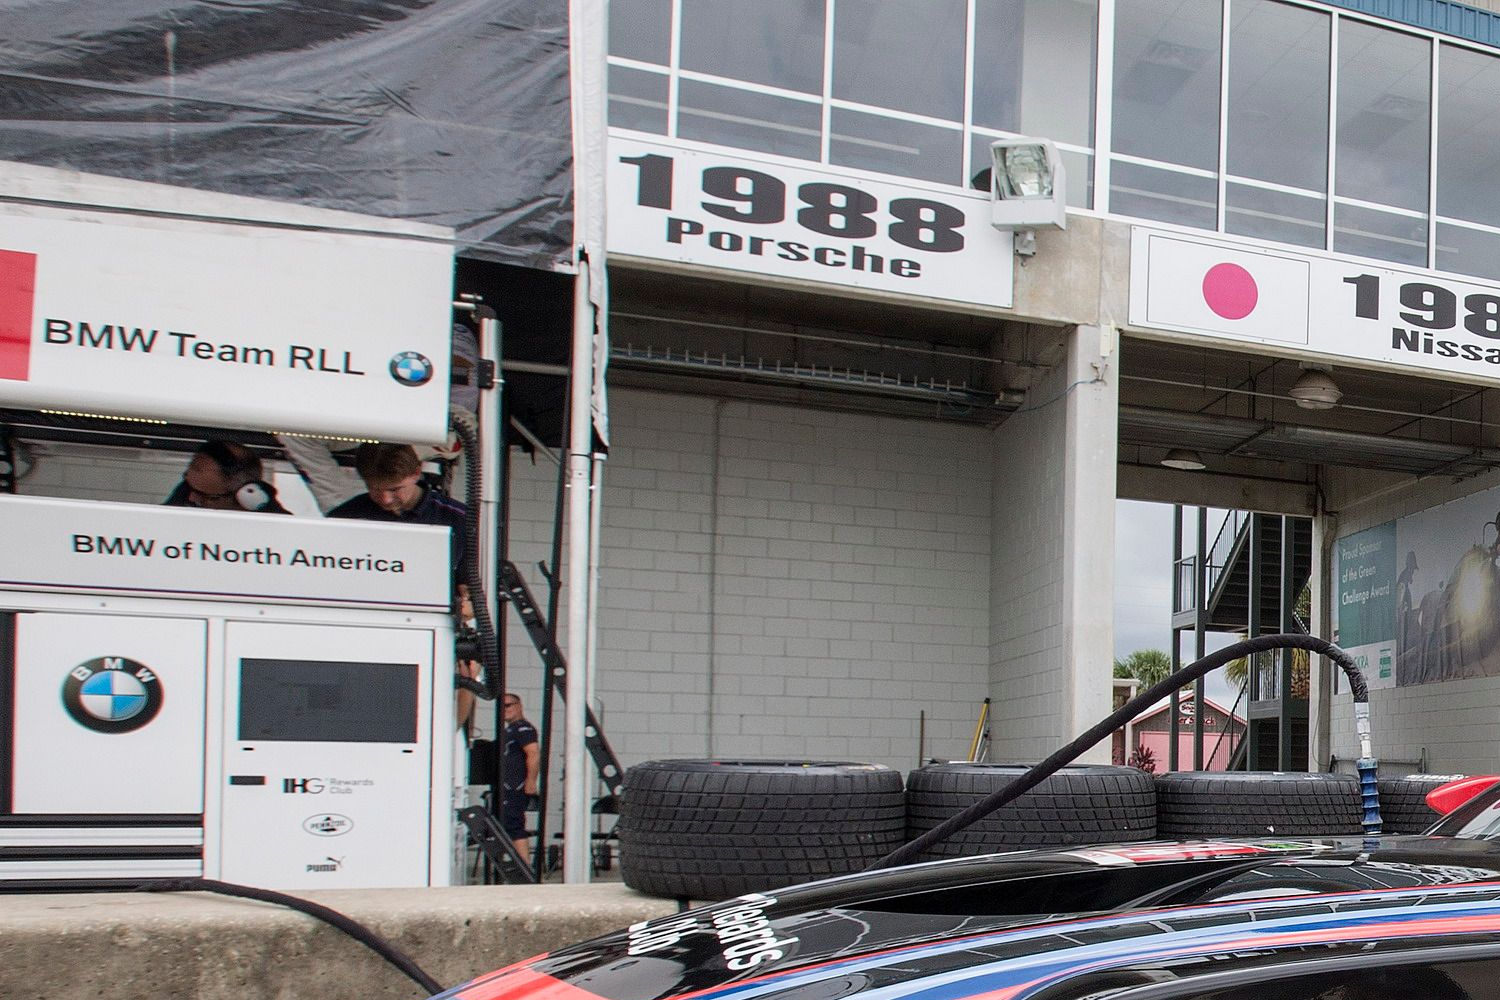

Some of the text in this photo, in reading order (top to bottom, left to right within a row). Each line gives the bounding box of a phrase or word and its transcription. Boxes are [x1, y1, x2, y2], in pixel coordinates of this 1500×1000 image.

[619, 153, 966, 253] 1988
[666, 217, 921, 279] Porsche
[44, 318, 366, 376] BMW Team RLL
[73, 535, 405, 573] BMW of North America
[71, 656, 155, 684] BMW
[283, 778, 325, 794] IHG
